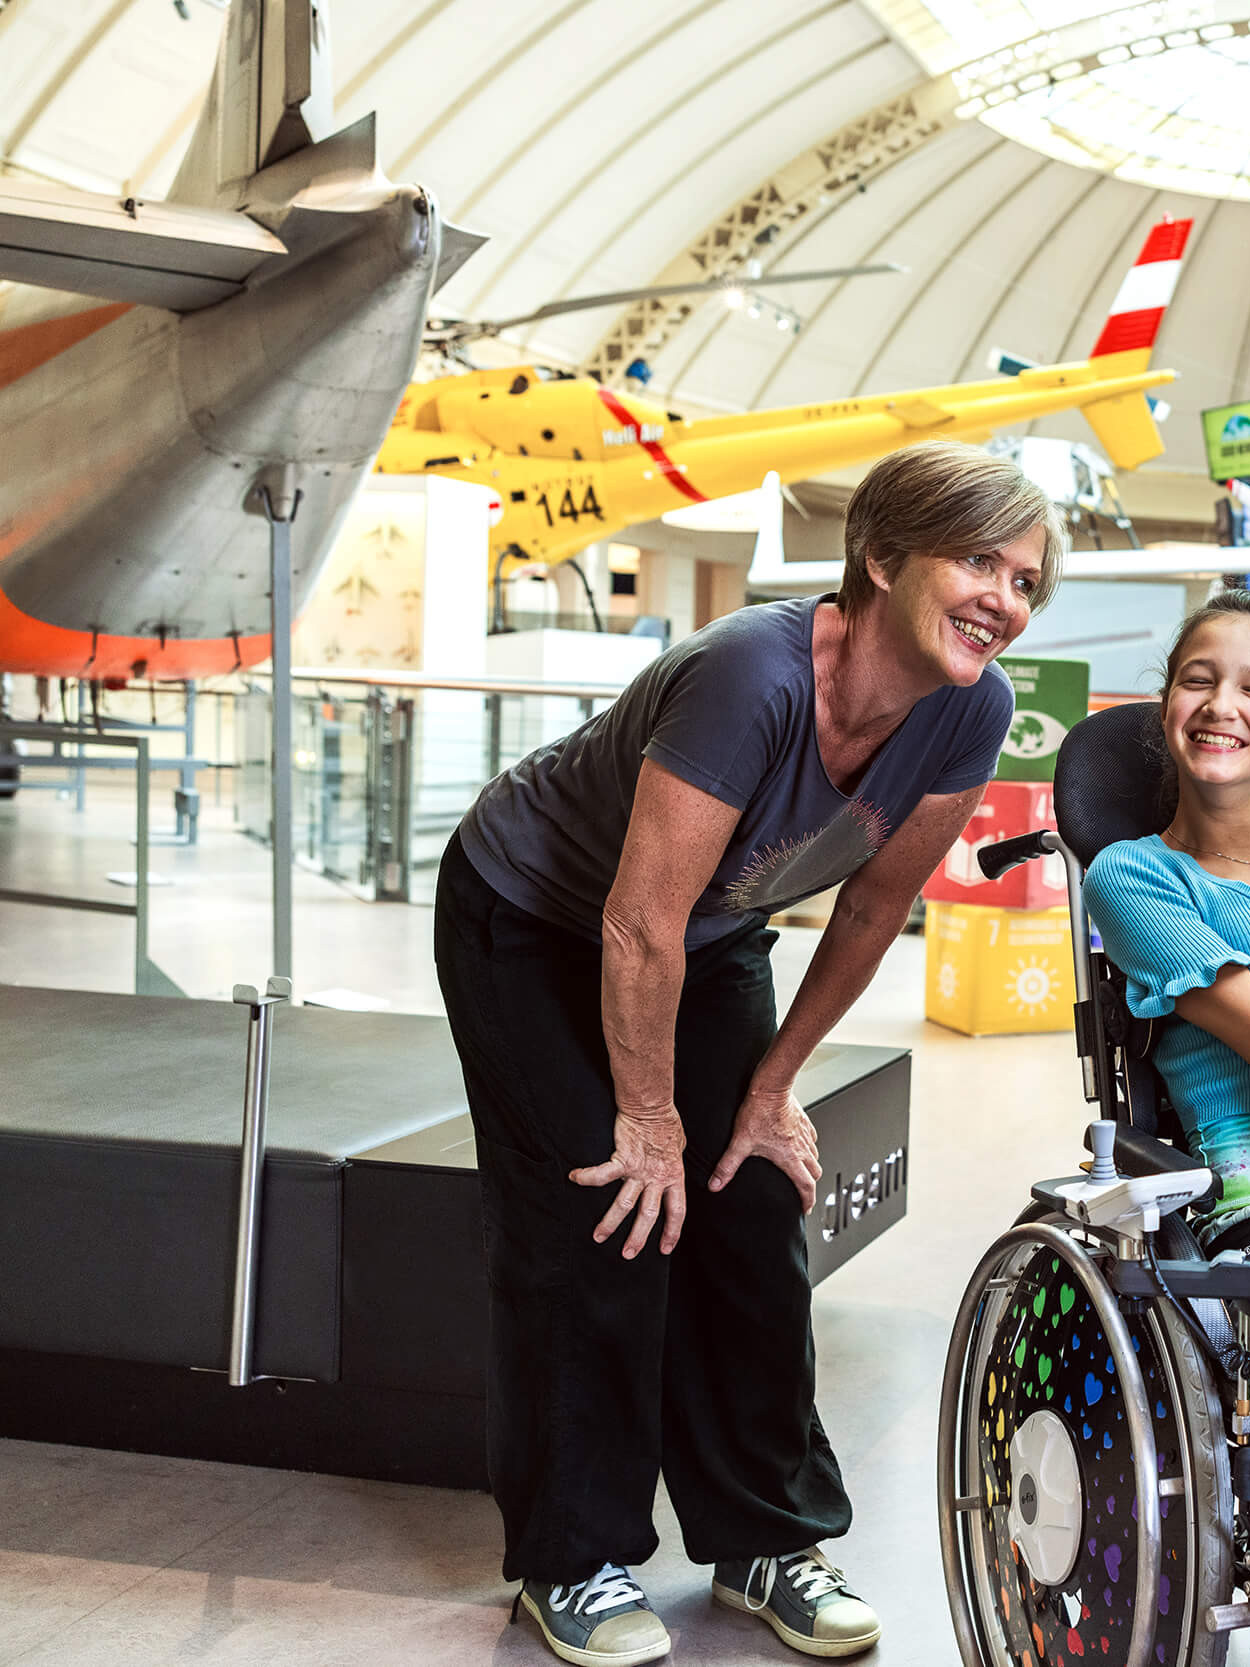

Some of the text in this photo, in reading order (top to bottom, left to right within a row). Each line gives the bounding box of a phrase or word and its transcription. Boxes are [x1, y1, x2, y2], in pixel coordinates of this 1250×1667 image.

[535, 483, 606, 527] 144
[988, 919, 1000, 947] 7
[821, 1146, 907, 1243] dream
